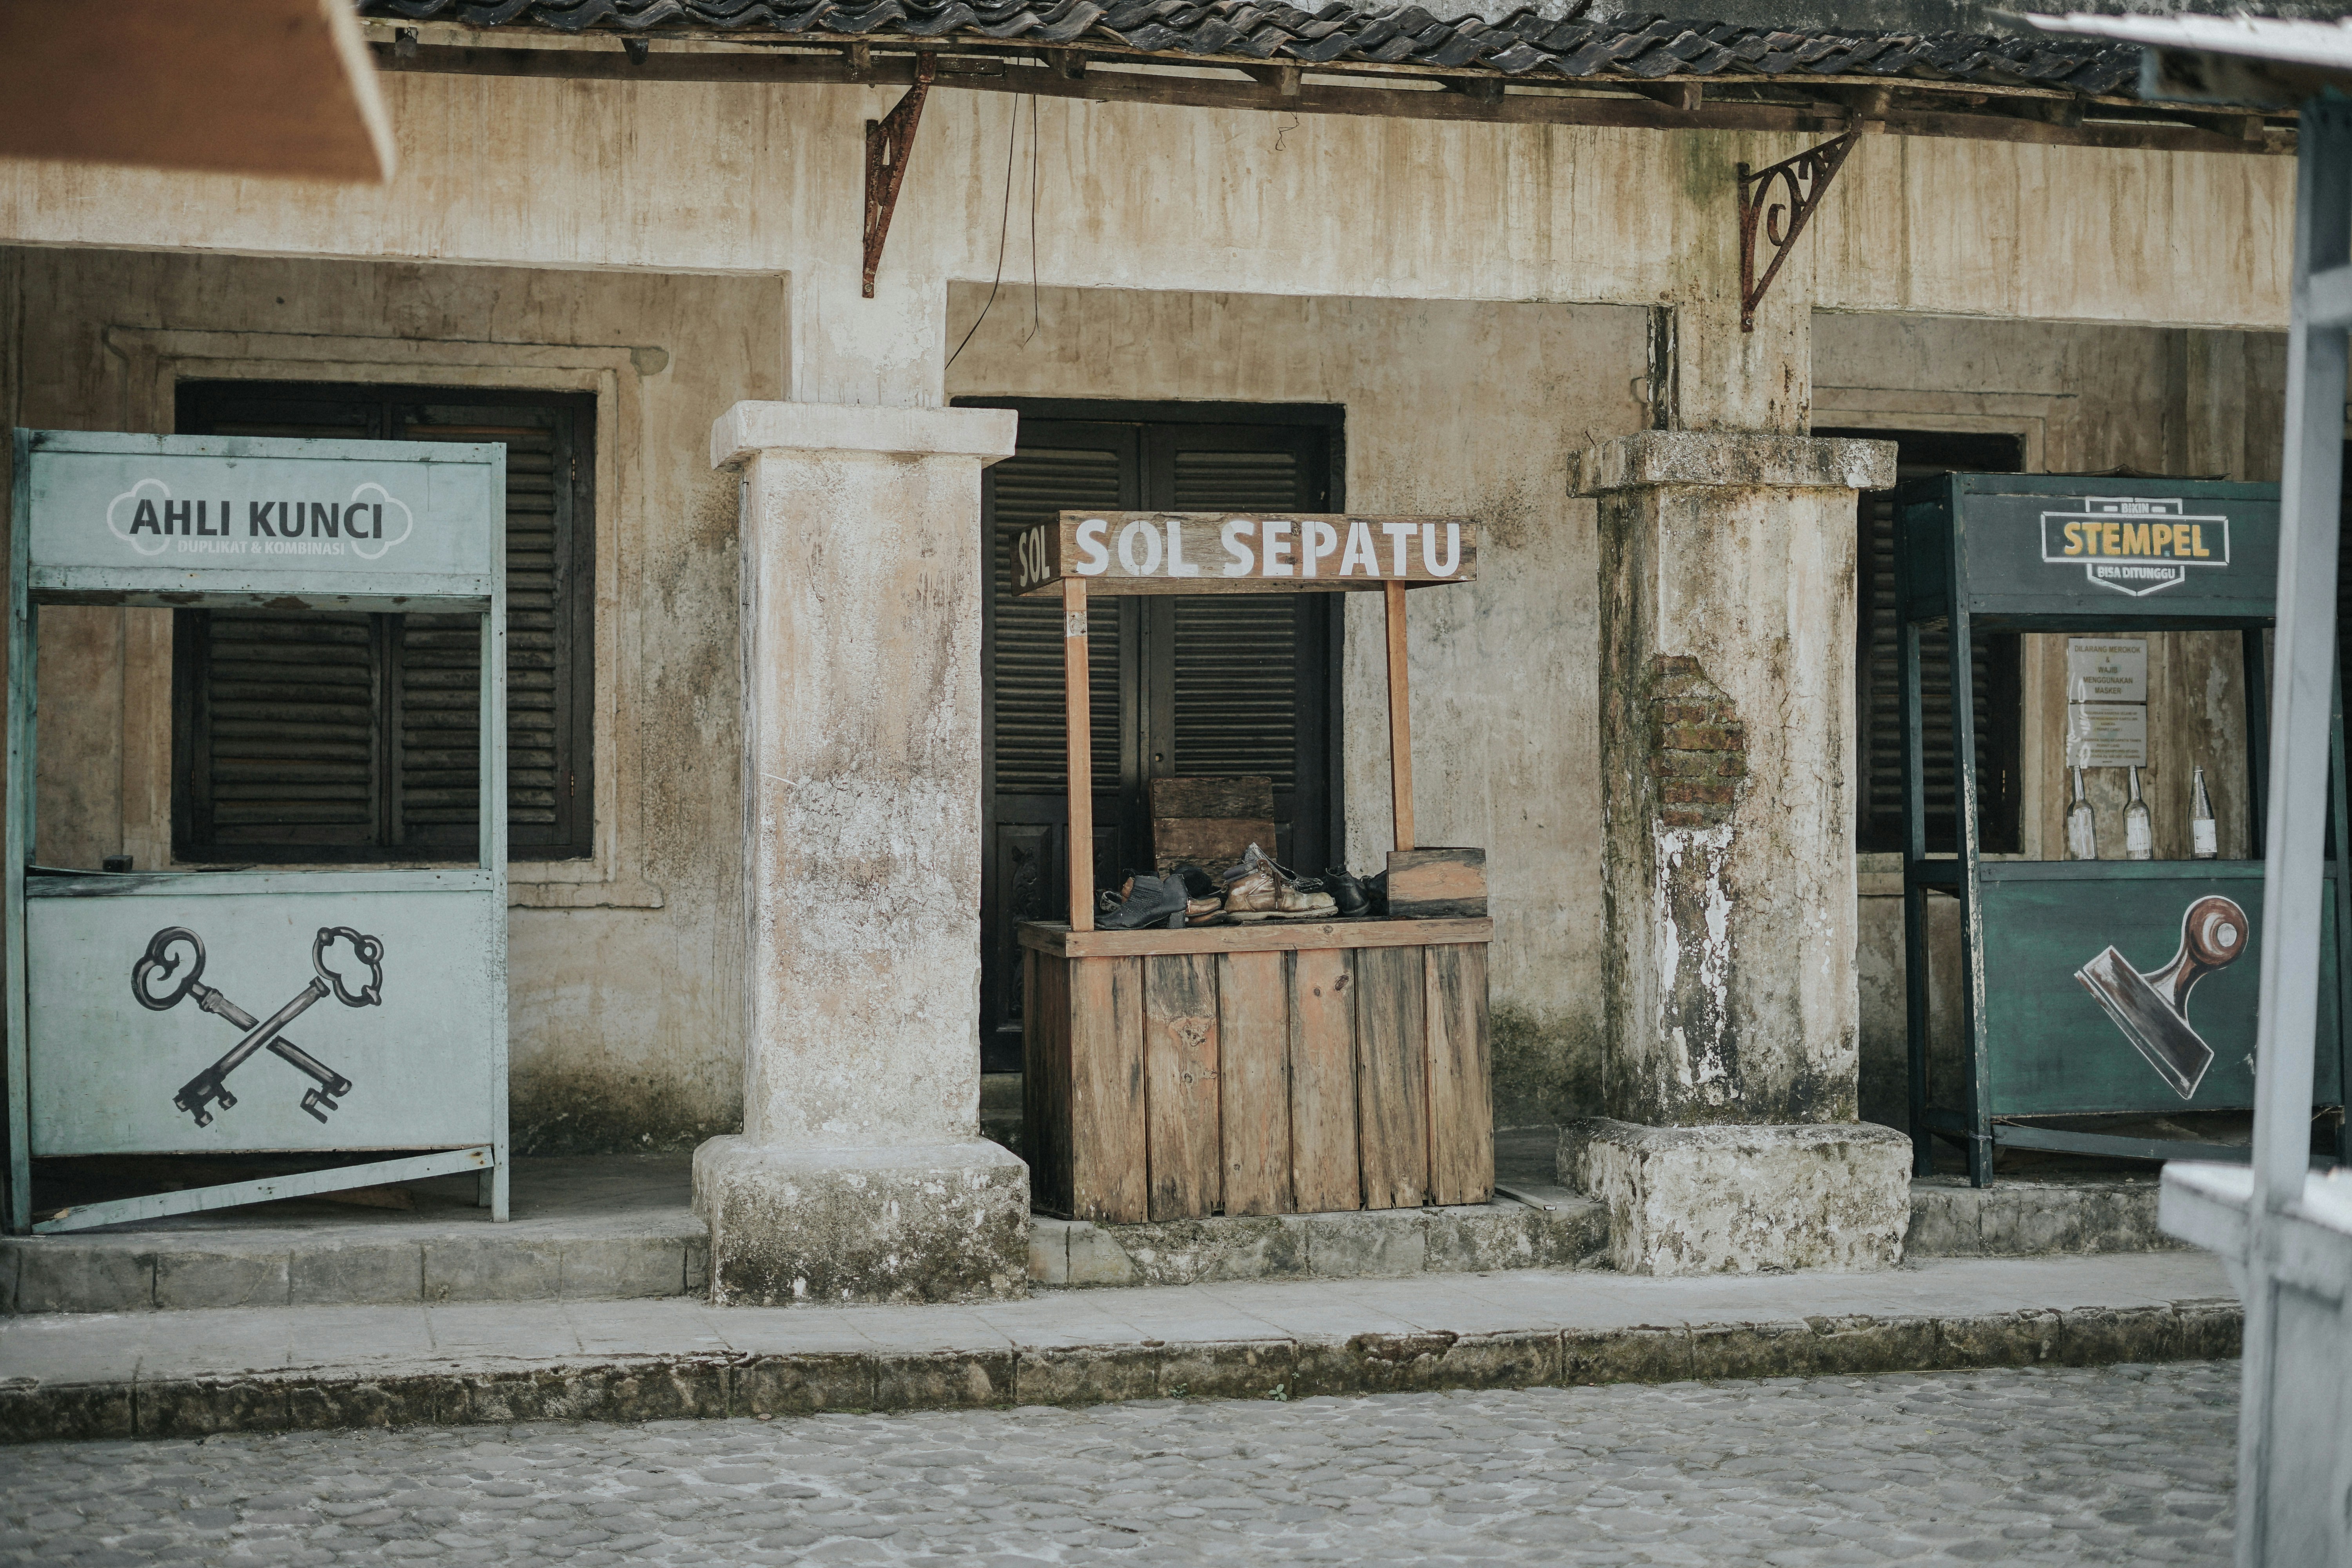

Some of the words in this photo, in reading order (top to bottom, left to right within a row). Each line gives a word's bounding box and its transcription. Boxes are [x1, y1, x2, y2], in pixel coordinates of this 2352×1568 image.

[129, 499, 230, 536] AHLI
[249, 501, 383, 539] KUNCI
[2121, 503, 2149, 513] BIKIN
[178, 540, 248, 553] DUPLIKAT
[250, 541, 262, 554] &
[265, 541, 345, 555] KOMBINASI
[1019, 525, 1050, 586] SOL
[1075, 519, 1198, 577] SOL
[1221, 520, 1460, 577] SEPATU
[2063, 521, 2210, 557] STEMPEL
[2098, 566, 2121, 578] BISA
[2122, 567, 2175, 579] DITUNGGU
